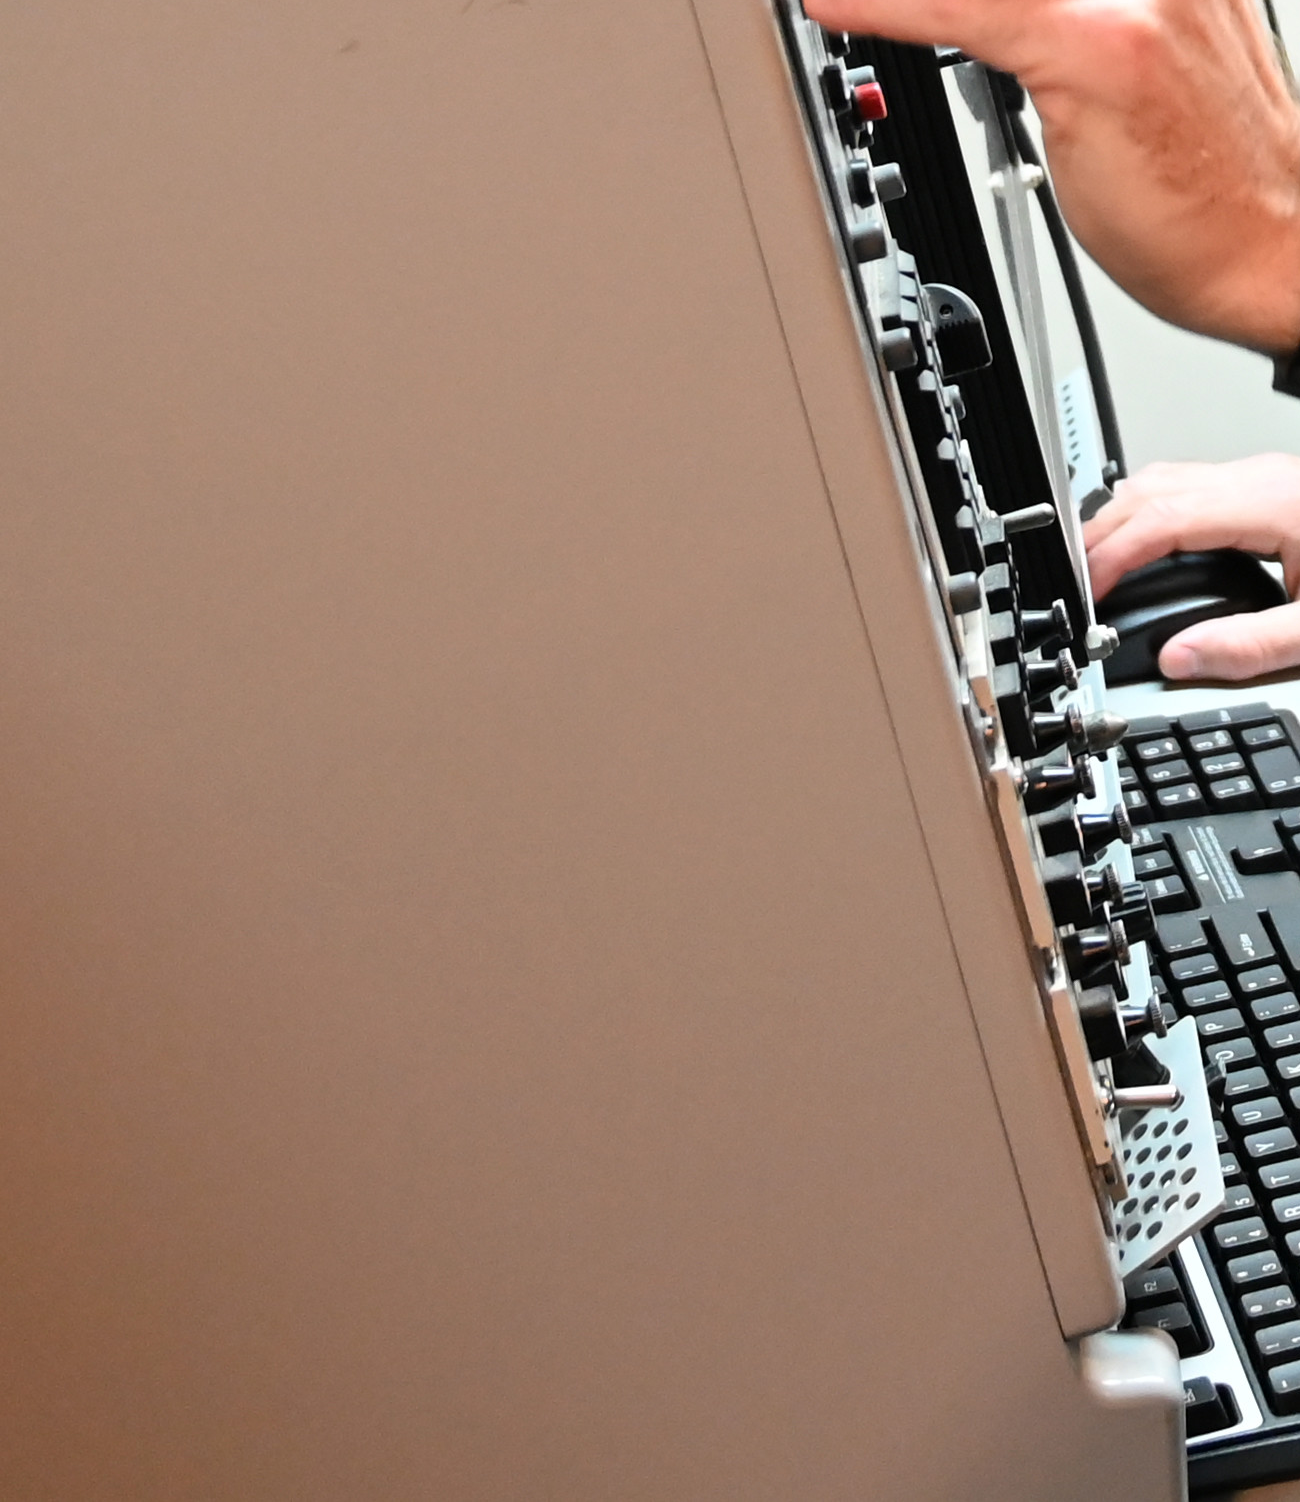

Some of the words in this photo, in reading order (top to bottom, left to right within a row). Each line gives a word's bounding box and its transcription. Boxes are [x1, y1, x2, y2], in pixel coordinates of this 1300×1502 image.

[1206, 763, 1222, 771] 2
[1153, 770, 1170, 779] 5
[1270, 780, 1287, 789] 0
[1205, 1023, 1224, 1032] P
[1276, 1034, 1294, 1045] L
[1242, 1110, 1262, 1122] U
[1255, 1142, 1275, 1152] Y
[1270, 1175, 1290, 1185] T
[1235, 1197, 1250, 1206] 5
[1262, 1262, 1277, 1272] 3
[1275, 1297, 1292, 1307] 2
